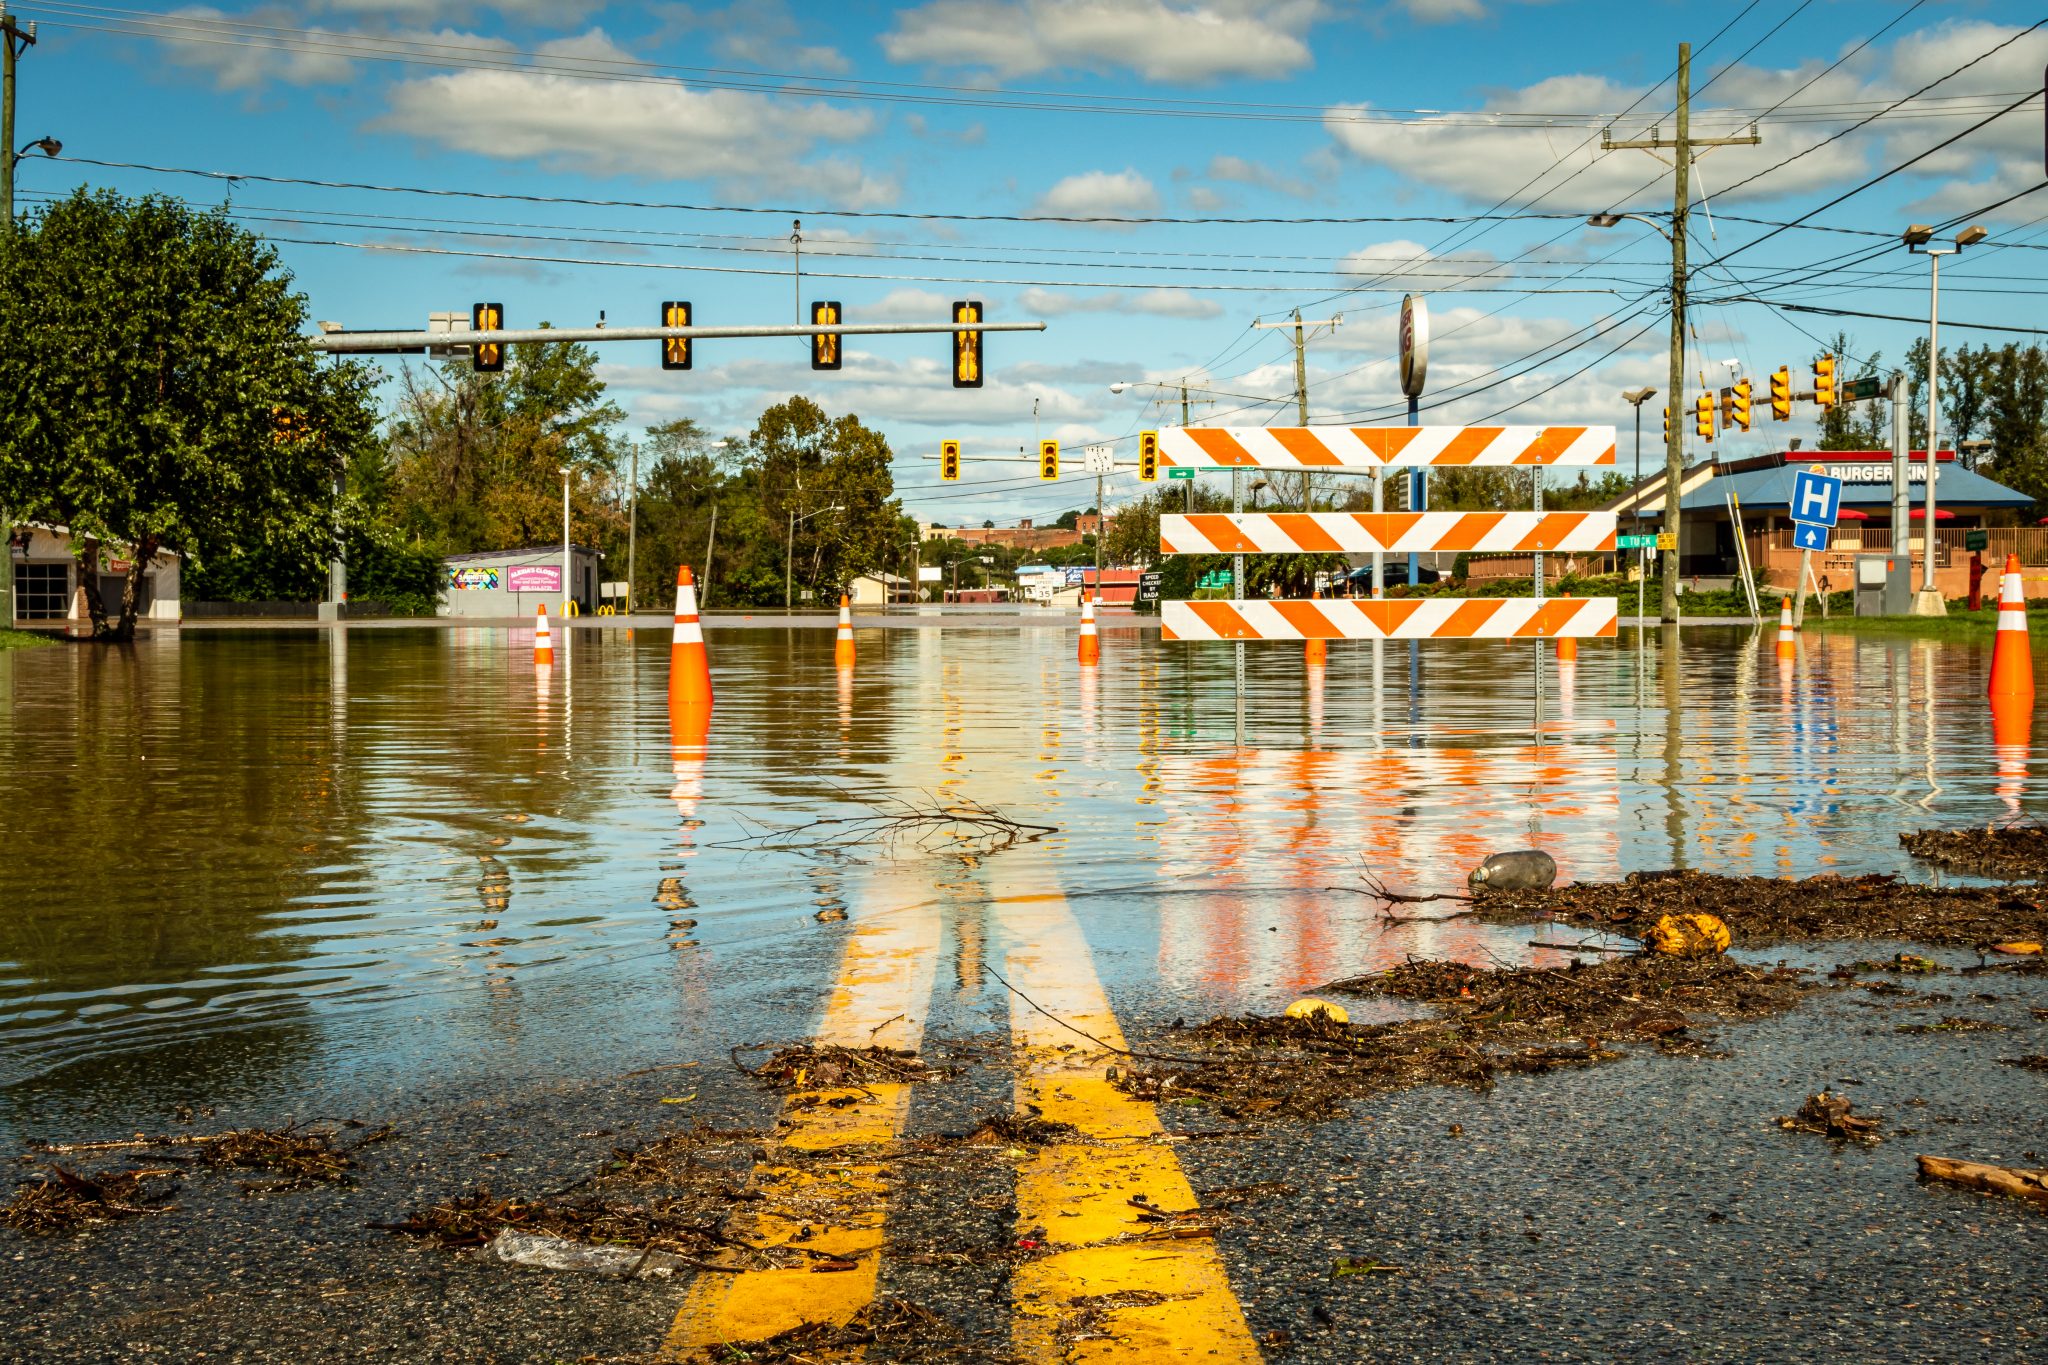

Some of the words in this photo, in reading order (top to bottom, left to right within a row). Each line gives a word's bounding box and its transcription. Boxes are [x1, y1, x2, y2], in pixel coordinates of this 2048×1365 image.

[1831, 466, 1892, 481] BURGER
[1801, 479, 1832, 519] H
[1039, 590, 1051, 598] 35
